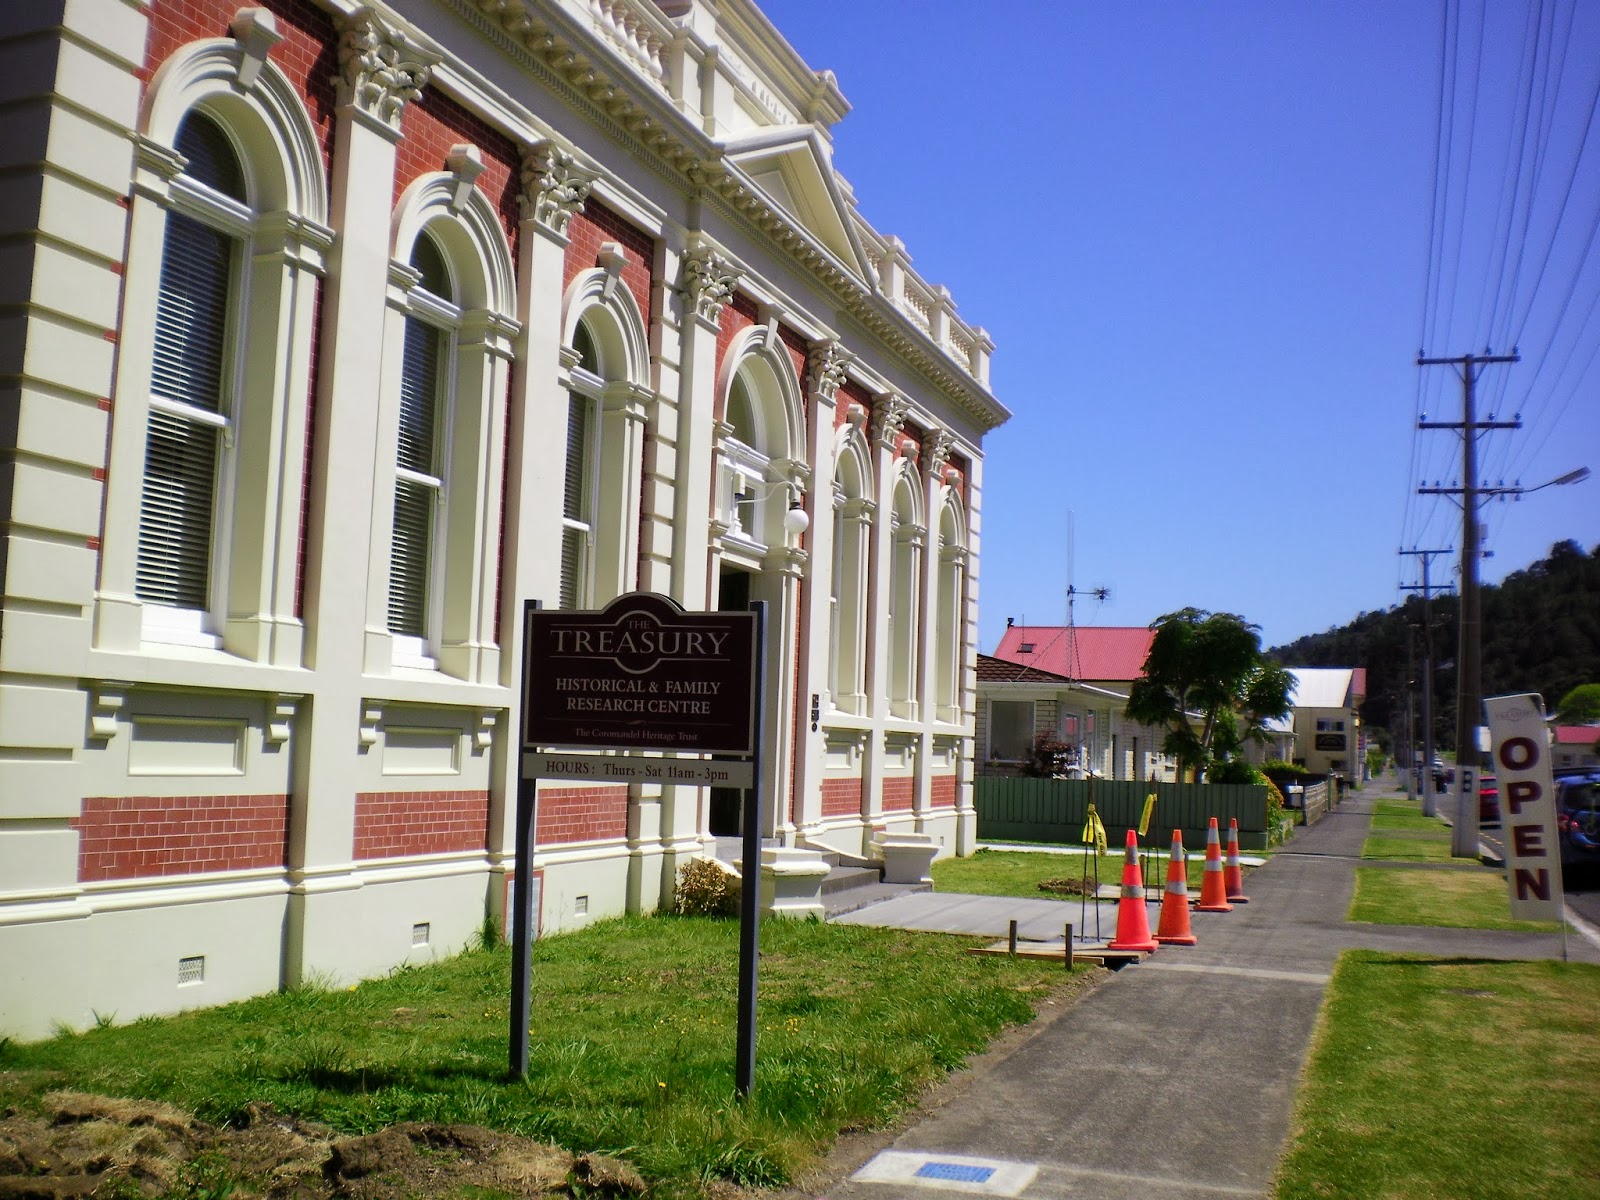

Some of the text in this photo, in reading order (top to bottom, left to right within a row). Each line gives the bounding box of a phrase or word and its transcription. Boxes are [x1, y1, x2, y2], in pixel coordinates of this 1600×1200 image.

[627, 620, 650, 629] THE
[550, 630, 729, 655] TREASURY
[556, 678, 721, 695] HISTORICAL & FAMILY
[567, 697, 711, 714] RESEARCH CENTRE
[576, 728, 698, 742] The Coromandel Heritage Trust
[603, 763, 635, 776] Thurs
[645, 766, 662, 777] Sat
[1500, 737, 1551, 901] OPEN
